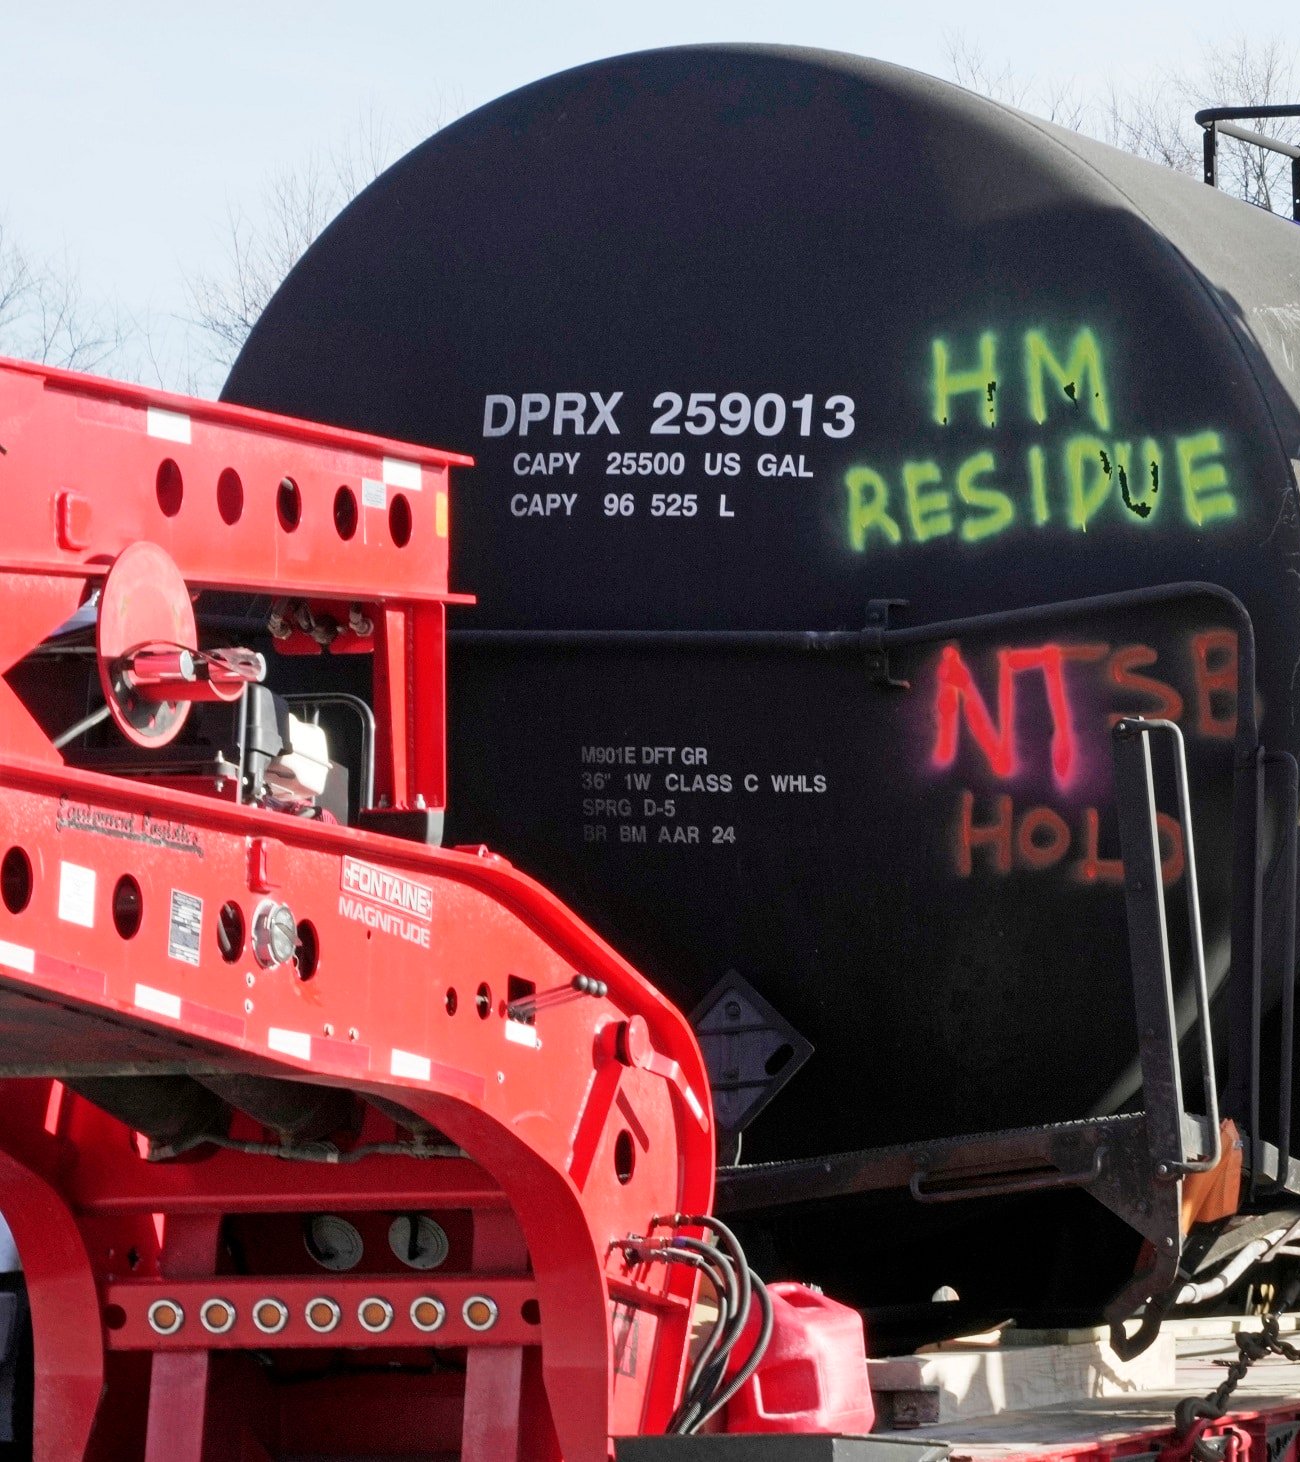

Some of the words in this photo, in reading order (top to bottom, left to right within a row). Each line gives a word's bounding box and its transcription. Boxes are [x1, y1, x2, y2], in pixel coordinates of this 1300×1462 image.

[932, 326, 1110, 431] HM
[483, 392, 623, 437] DPRX
[650, 391, 855, 438] 259013
[513, 452, 581, 476] CAPY
[606, 452, 685, 475] 25500
[704, 453, 741, 476] US
[757, 454, 814, 478] GAL
[510, 494, 578, 517] CAPY
[603, 493, 635, 516] 96
[650, 494, 698, 516] 525
[719, 494, 735, 517] L
[845, 430, 1237, 553] RESIDUE
[932, 628, 1239, 791] NTSB
[581, 747, 636, 764] M901E
[642, 747, 675, 765] DFT
[681, 747, 708, 765] GR
[581, 773, 611, 790] 36"
[624, 773, 651, 791] 1W
[665, 773, 733, 793] CLASS
[744, 774, 759, 792] C
[771, 774, 827, 793] WHLS
[582, 799, 632, 817] SPRG
[644, 799, 676, 817] D-5
[620, 825, 647, 843] BM
[658, 826, 700, 844] AAR
[711, 826, 736, 844] 24
[347, 861, 430, 915] FONTAINE
[339, 896, 430, 949] MAGNITUDE
